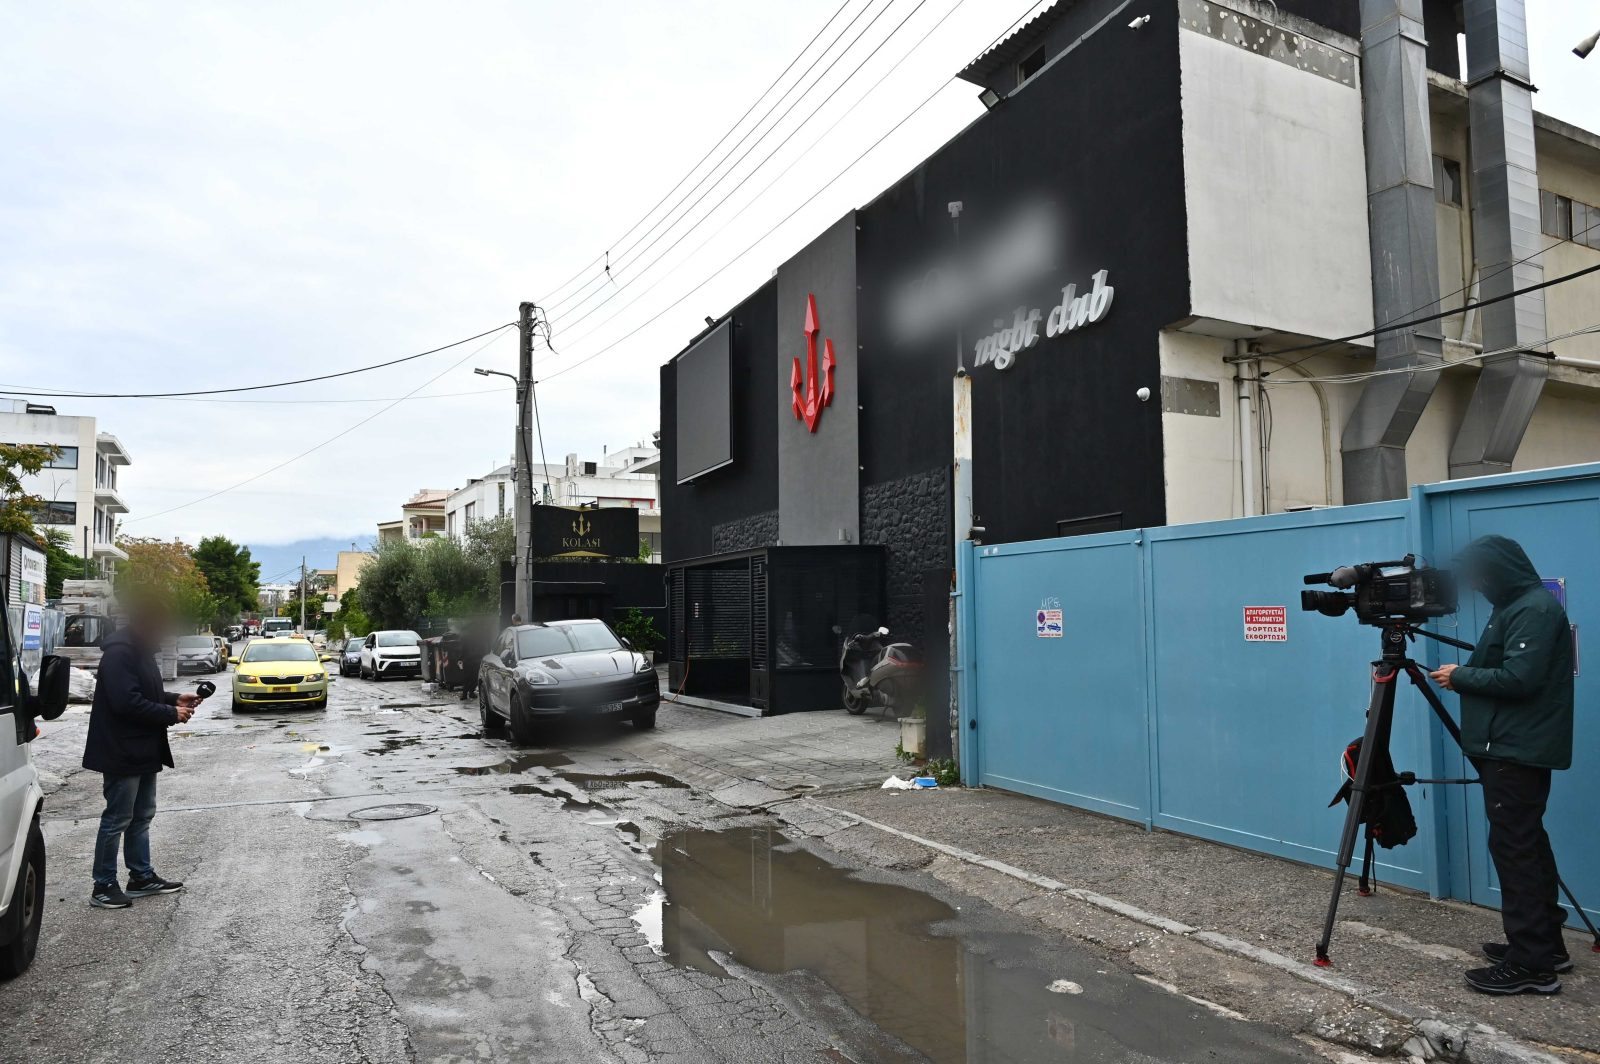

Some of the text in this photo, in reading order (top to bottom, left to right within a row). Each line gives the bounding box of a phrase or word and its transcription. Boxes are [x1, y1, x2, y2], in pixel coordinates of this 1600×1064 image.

[974, 269, 1115, 370] night club
[562, 537, 600, 547] KOLASI
